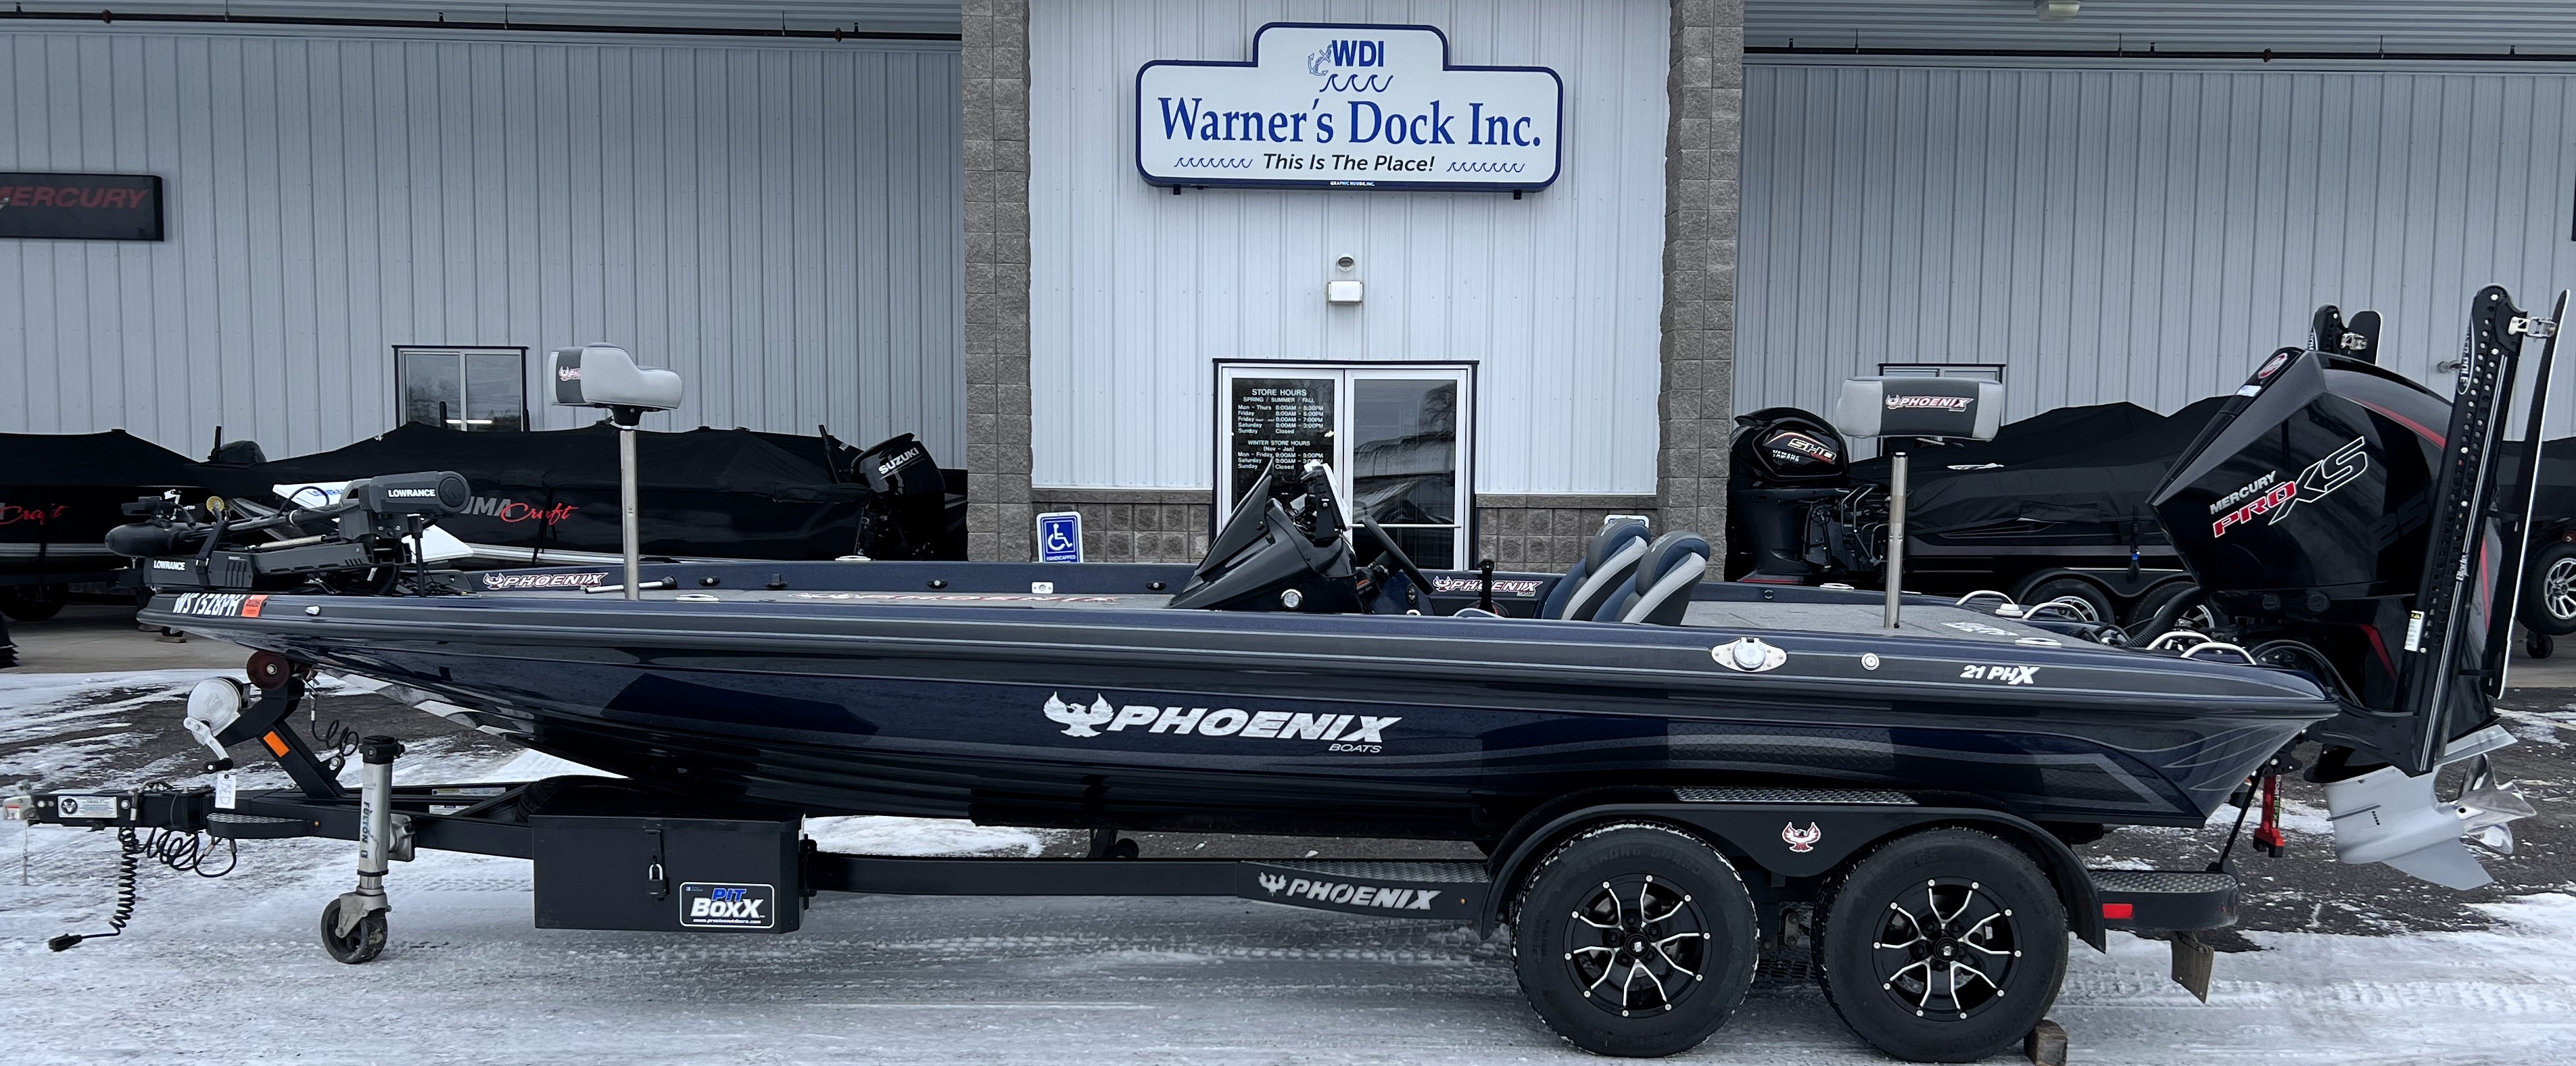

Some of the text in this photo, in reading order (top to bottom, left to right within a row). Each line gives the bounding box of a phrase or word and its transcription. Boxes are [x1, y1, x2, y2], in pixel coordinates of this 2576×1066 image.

[1331, 39, 1383, 68] WDI
[1158, 97, 1541, 147] Warner's Dock Inc.
[1263, 153, 1435, 172] This Is The Place!
[1899, 396, 1974, 408] PHOENIX
[879, 447, 920, 474] SUZUKI
[387, 488, 436, 498] LOWRANCE
[2210, 470, 2276, 515] MERCURY
[2212, 481, 2297, 538] PRO
[153, 560, 186, 571] LOWRANCE
[504, 573, 609, 587] PHOENIX
[1959, 664, 2040, 685] 21 PHX
[1107, 704, 1402, 743] PHOENIX
[1329, 743, 1383, 753] BOATS
[219, 779, 233, 805] USED
[362, 801, 371, 844] FULTON
[711, 887, 747, 902] PIT
[1285, 878, 1442, 911] PHOENIX
